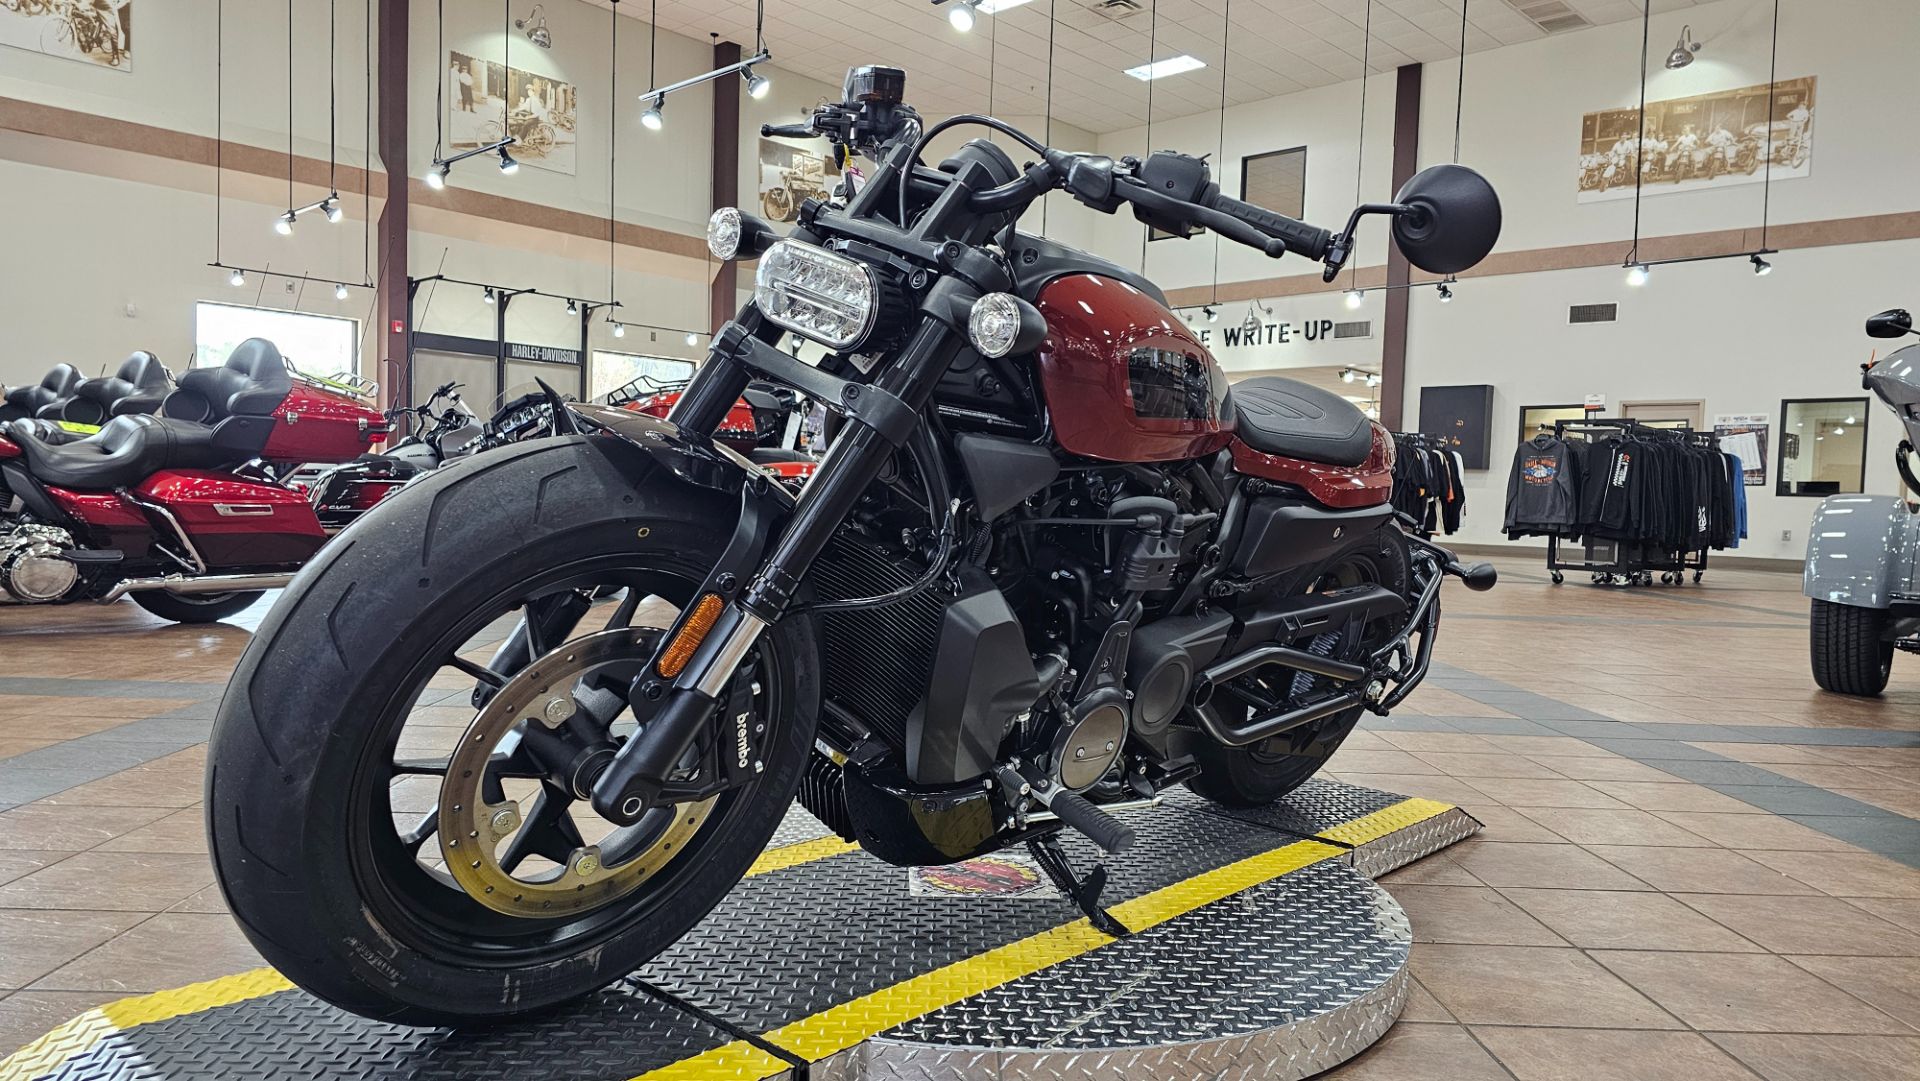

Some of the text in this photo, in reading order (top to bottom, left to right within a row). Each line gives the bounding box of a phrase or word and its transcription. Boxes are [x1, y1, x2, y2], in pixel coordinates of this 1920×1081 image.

[1224, 319, 1333, 347] WRITE-UP
[511, 344, 577, 364] HARLEY-DAVIDSON
[736, 711, 750, 768] brembo
